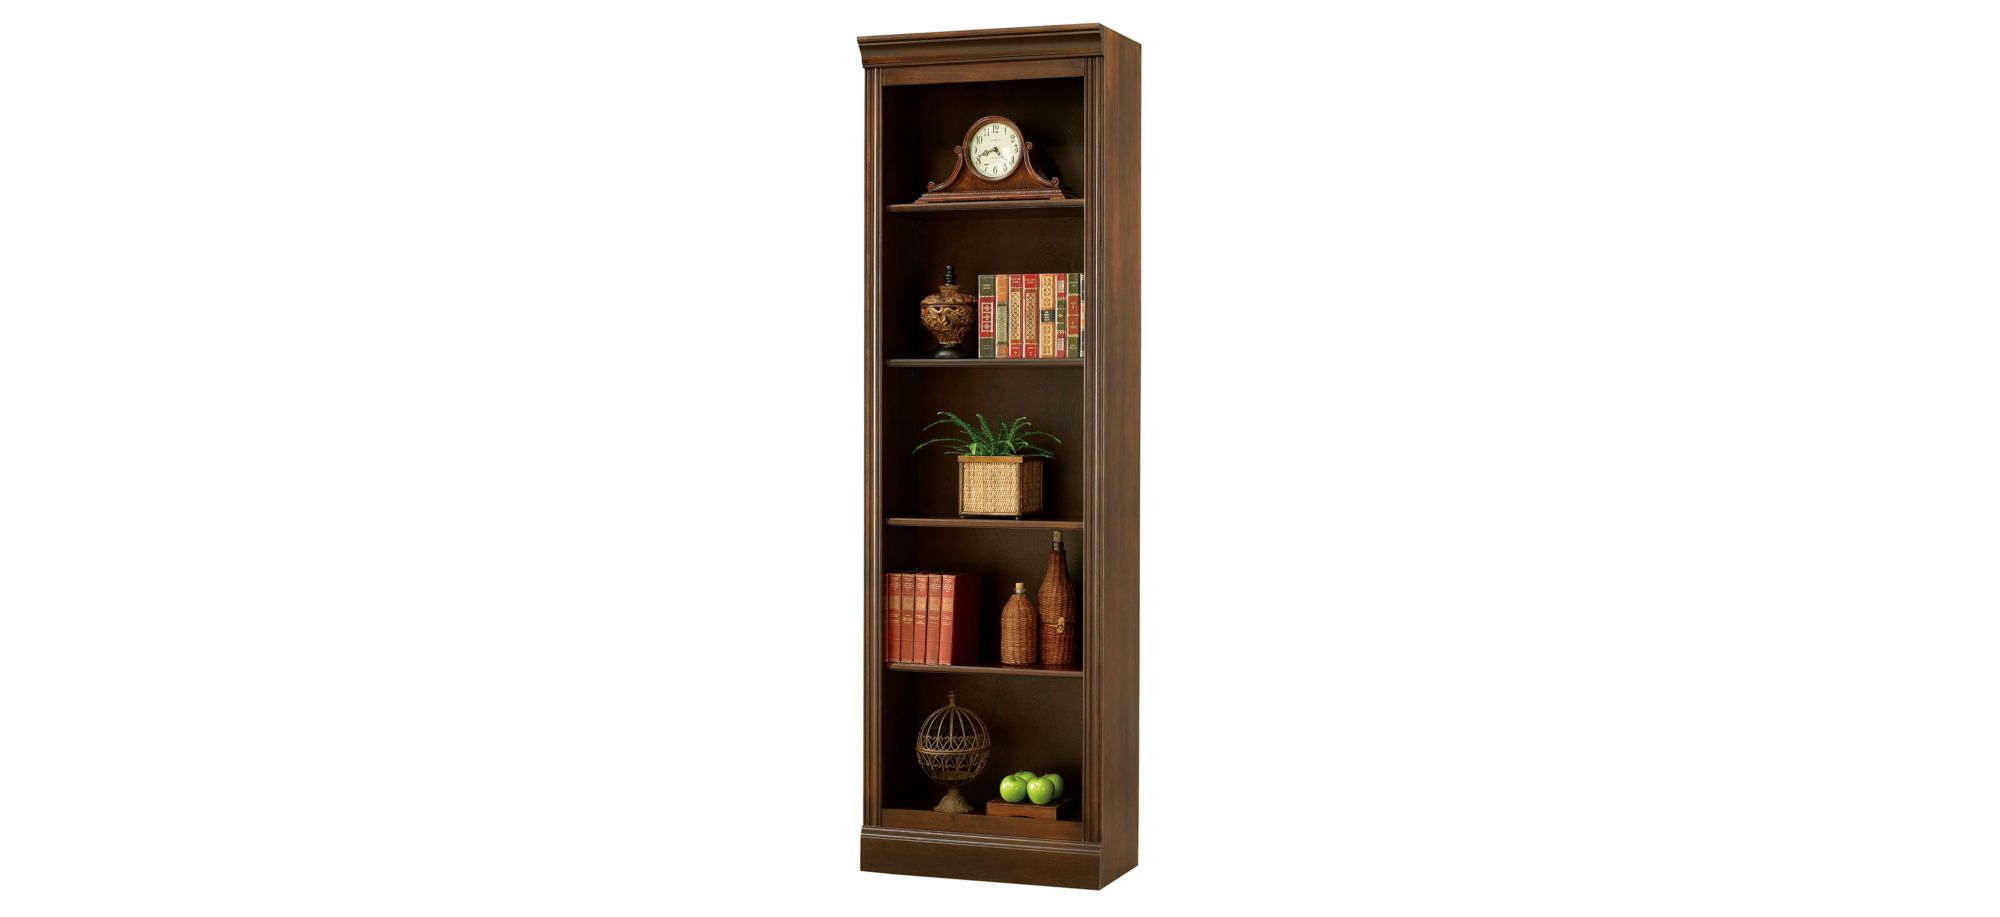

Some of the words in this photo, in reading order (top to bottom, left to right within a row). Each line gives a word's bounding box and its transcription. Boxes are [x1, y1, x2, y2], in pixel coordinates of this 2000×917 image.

[984, 128, 990, 137] 11
[992, 125, 999, 133] 12
[1010, 134, 1015, 143] 2
[1014, 144, 1019, 153] 3
[984, 163, 989, 172] 7
[992, 166, 998, 174] 6
